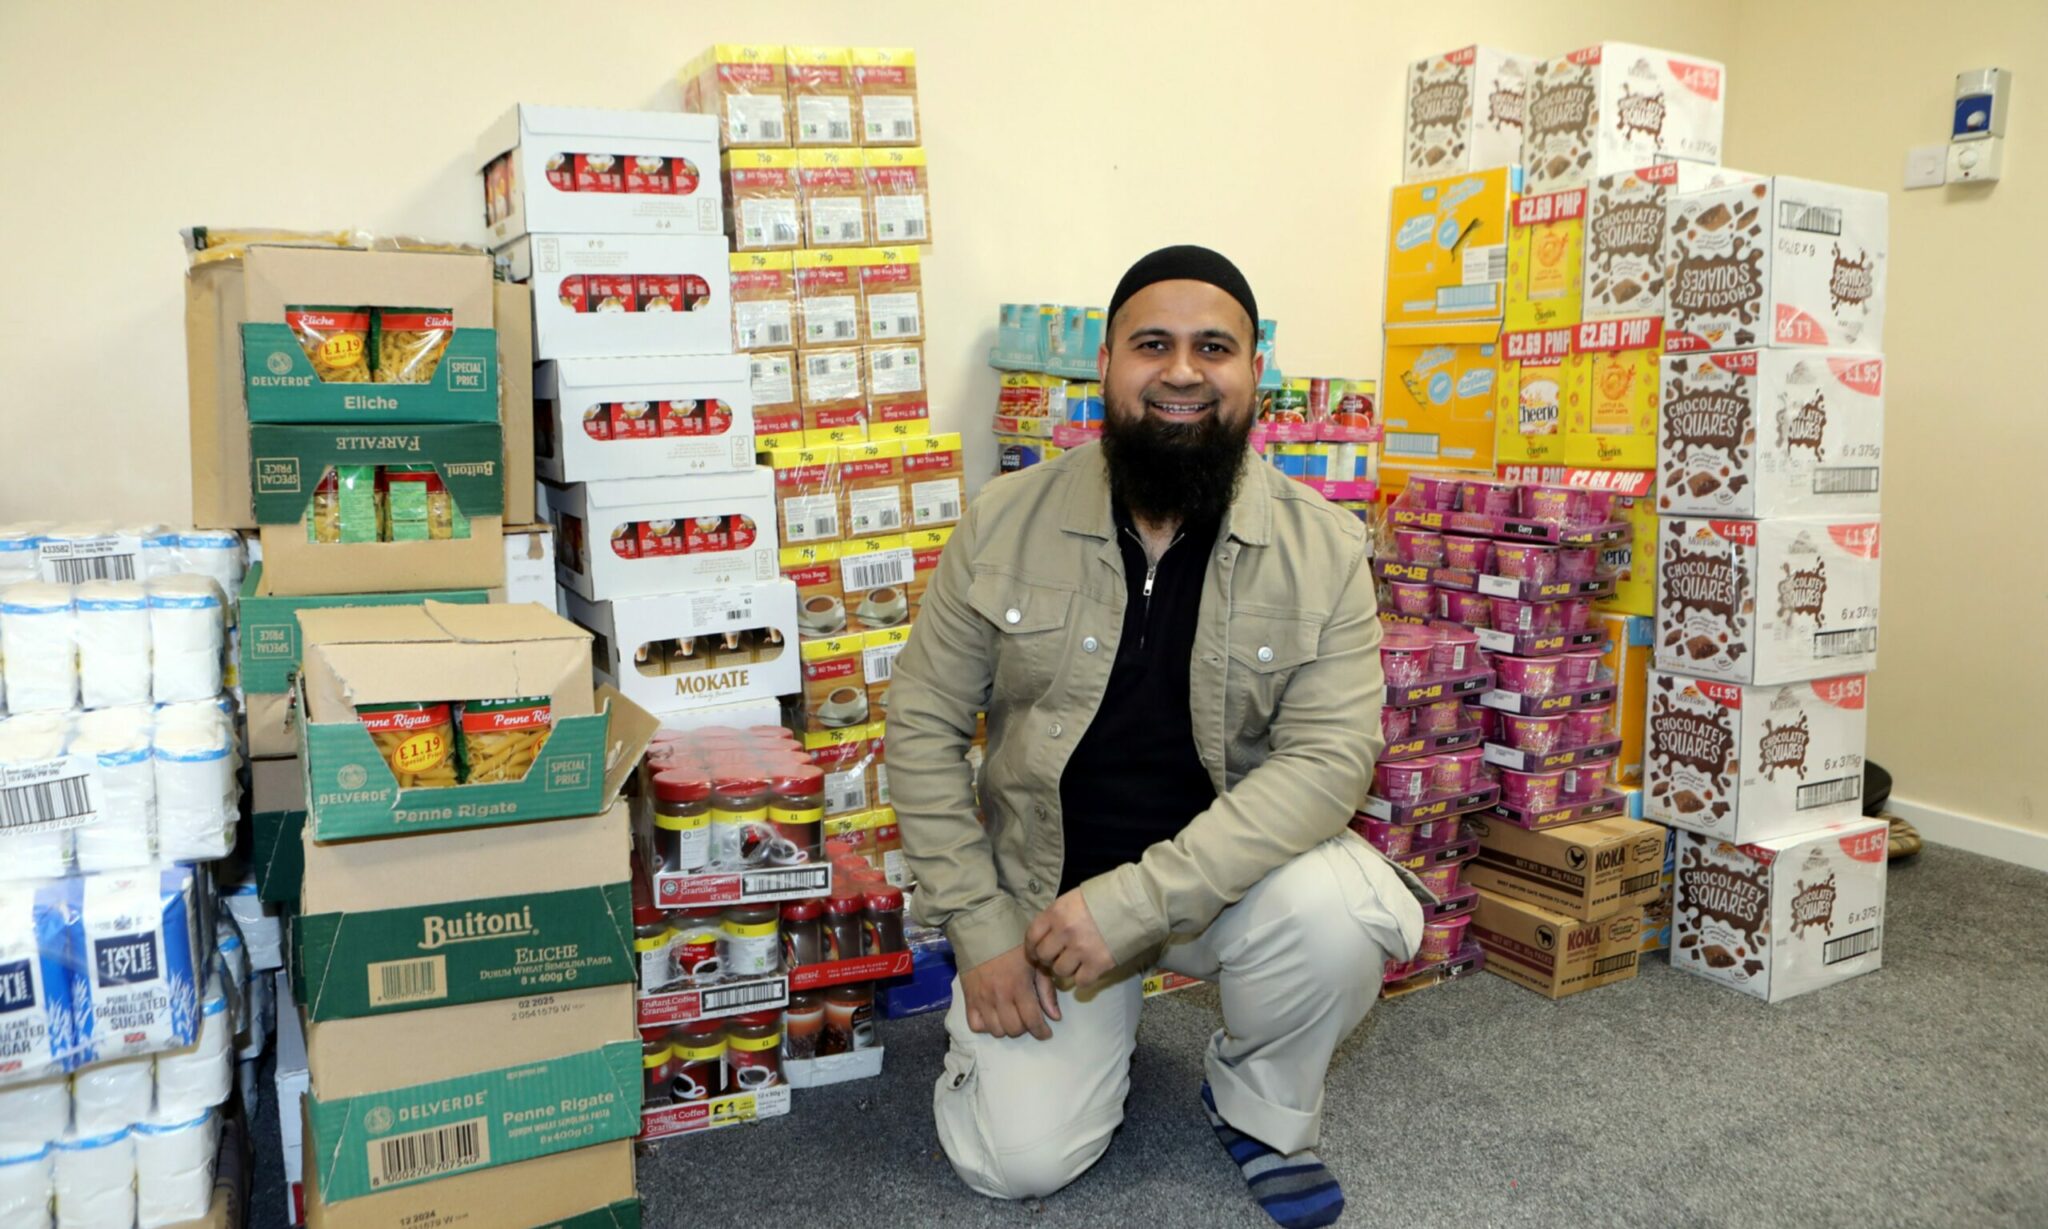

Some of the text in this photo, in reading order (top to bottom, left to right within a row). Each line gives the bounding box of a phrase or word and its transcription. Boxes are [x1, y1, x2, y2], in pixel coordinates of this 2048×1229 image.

[1413, 85, 1465, 105] CHOCOLATEY
[1532, 87, 1590, 111] CHOCOLATEY
[1415, 101, 1459, 120] SQUARES
[1534, 105, 1585, 128] SQUARES
[1622, 108, 1661, 129] SQUARES
[1647, 166, 1675, 180] £1.95
[1519, 191, 1581, 222] £2.69 PMP
[1595, 207, 1664, 233] CHOCOLATEY
[1599, 222, 1658, 250] SQUARES
[752, 256, 766, 266] 75p
[820, 253, 833, 262] 75p
[883, 251, 896, 260] 75p
[1681, 263, 1750, 292] SQUARES
[1676, 285, 1756, 309] CHOCOLATEY
[300, 314, 335, 327] Eliche
[1580, 319, 1649, 349] £2.69 PMP
[324, 339, 362, 356] £1.19
[1509, 333, 1548, 357] £2.69
[1667, 338, 1695, 350] £1.95
[451, 362, 482, 374] SPECIAL
[1725, 355, 1754, 368] £1.95
[456, 374, 479, 386] PRICE
[1845, 364, 1880, 381] £1.95
[252, 376, 311, 387] DELVERDE
[344, 396, 398, 410] Eliche
[1668, 397, 1744, 419] CHOCOLATEY
[894, 425, 907, 434] 75p
[1673, 415, 1738, 438] SQUARES
[336, 436, 421, 451] FARFALLE
[764, 439, 778, 448] 75p
[830, 432, 844, 441] 75p
[925, 440, 939, 449] 75p
[800, 452, 813, 462] 75p
[865, 446, 878, 455] 75p
[1597, 447, 1622, 459] Cheerios
[265, 464, 292, 474] PRICE
[448, 462, 495, 478] Buitoni
[876, 462, 889, 470] Bags
[261, 474, 298, 485] SPECIAL
[1612, 471, 1645, 492] PMP
[1395, 511, 1443, 527] KO-LEE
[928, 533, 941, 542] 75p
[1518, 525, 1532, 534] Curry
[42, 545, 69, 555] 433582
[866, 541, 880, 550] 75p
[1384, 564, 1428, 581] KO-LEE
[1667, 562, 1742, 582] CHOCOLATEY
[1541, 584, 1571, 595] KO-LEE
[1671, 577, 1733, 604] SQUARES
[260, 630, 284, 640] PRICE
[1535, 637, 1564, 649] KO-LEE
[255, 642, 290, 654] SPECIAL
[837, 661, 851, 671] Bags
[675, 670, 750, 696] MOKATE
[1408, 681, 1475, 700] KO-LEE Curry
[1828, 680, 1862, 699] £1.95
[1541, 692, 1601, 709] KO-LEE Curry
[1709, 689, 1738, 701] £1.95
[394, 712, 431, 728] Rigate
[494, 712, 529, 727] Penne
[1655, 719, 1727, 746] CHOCOLATEY
[1762, 731, 1807, 748] CHOCOLATEY
[1389, 741, 1424, 754] KO-LEE
[1659, 732, 1721, 764] SQUARES
[1765, 744, 1803, 765] SQUARES
[1544, 752, 1575, 765] KO-LEE
[1824, 754, 1862, 770] 6 x 375g
[550, 761, 586, 774] SPECIAL
[555, 773, 580, 786] PRICE
[319, 790, 388, 805] DELVERDE
[395, 801, 518, 824] Penne Rigate
[1413, 802, 1447, 818] KO-LEE
[1496, 806, 1509, 817] Curry
[1538, 809, 1572, 824] KO-LEE
[1855, 833, 1884, 856] £1.95
[1595, 847, 1625, 872] KOKA
[1684, 871, 1766, 904] CHOCOLATEY
[1688, 884, 1758, 921] SQUARES
[1794, 889, 1834, 909] CHOCOLATEY
[1797, 899, 1831, 922] SQUARES
[418, 905, 533, 949] Buitoni
[1849, 914, 1861, 925] 6 x
[1567, 926, 1601, 951] KOKA
[516, 944, 578, 962] ELICHE
[480, 955, 612, 980] DURUM WHEAT SEMOLINA PASTA
[530, 976, 537, 984] x
[539, 972, 564, 984] 400g
[106, 994, 128, 1005] PURE
[519, 996, 554, 1008] 02 2025
[672, 994, 697, 1004] Coffee
[96, 997, 167, 1018] GRANULATED
[641, 1004, 678, 1016] Granules
[111, 1012, 155, 1030] SUGAR
[399, 1094, 485, 1122] DELVERDE
[503, 1092, 614, 1125] Penne Rigate
[647, 1108, 706, 1125] Instant Coffee
[400, 1209, 436, 1226] 12 2024
